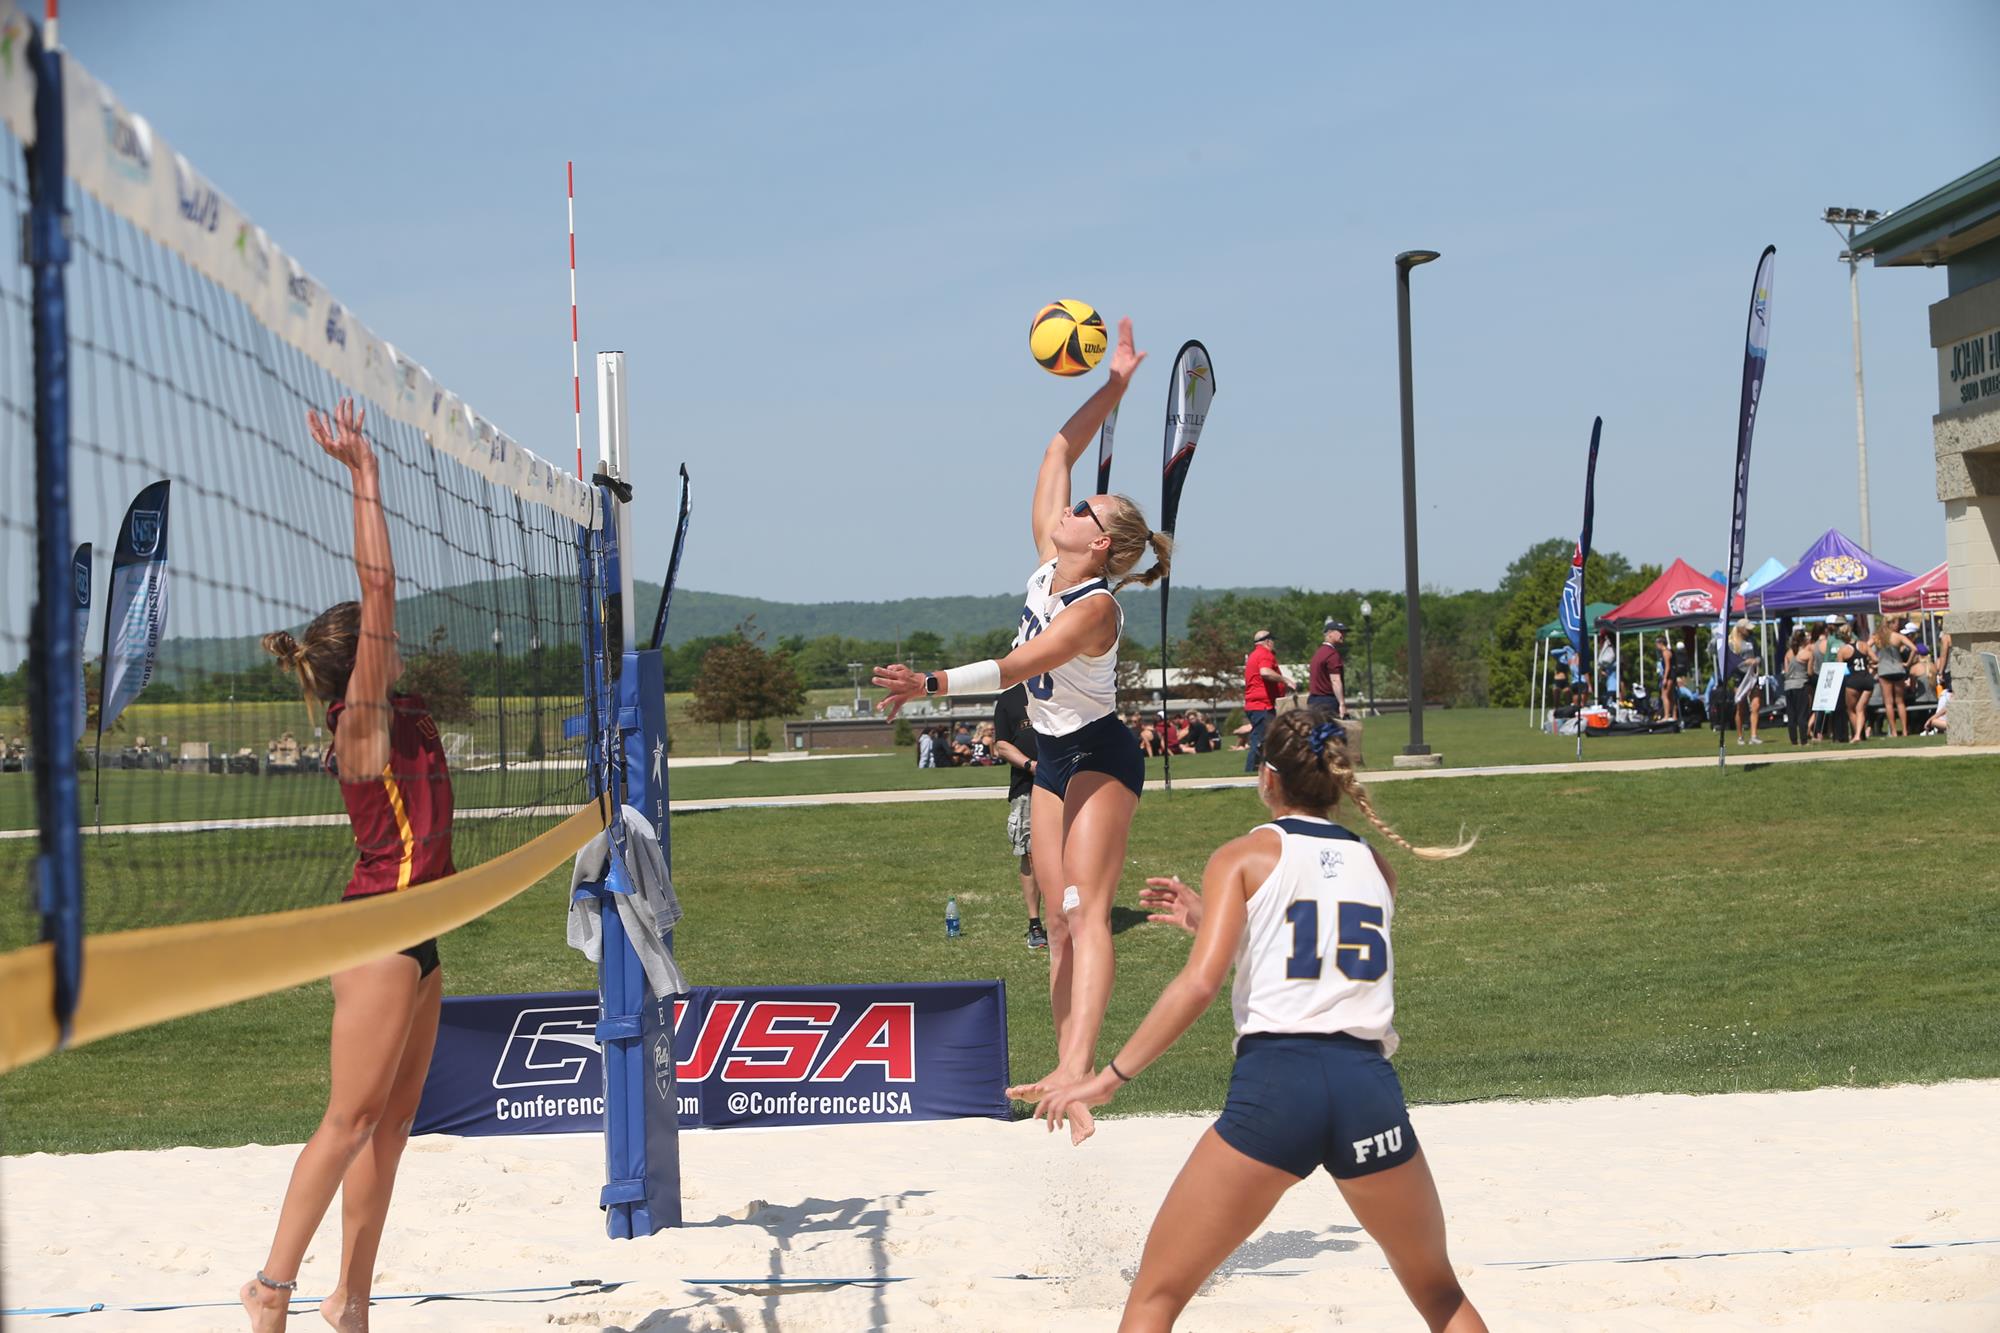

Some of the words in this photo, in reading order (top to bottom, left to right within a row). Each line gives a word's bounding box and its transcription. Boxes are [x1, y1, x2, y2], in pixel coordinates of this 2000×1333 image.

[1950, 337, 1985, 382] JOHN
[141, 651, 155, 688] PORTS
[1854, 658, 1866, 671] 21
[1285, 898, 1388, 983] 15
[728, 1091, 913, 1115] @ConferenceUSA
[1352, 1125, 1402, 1164] FIU
